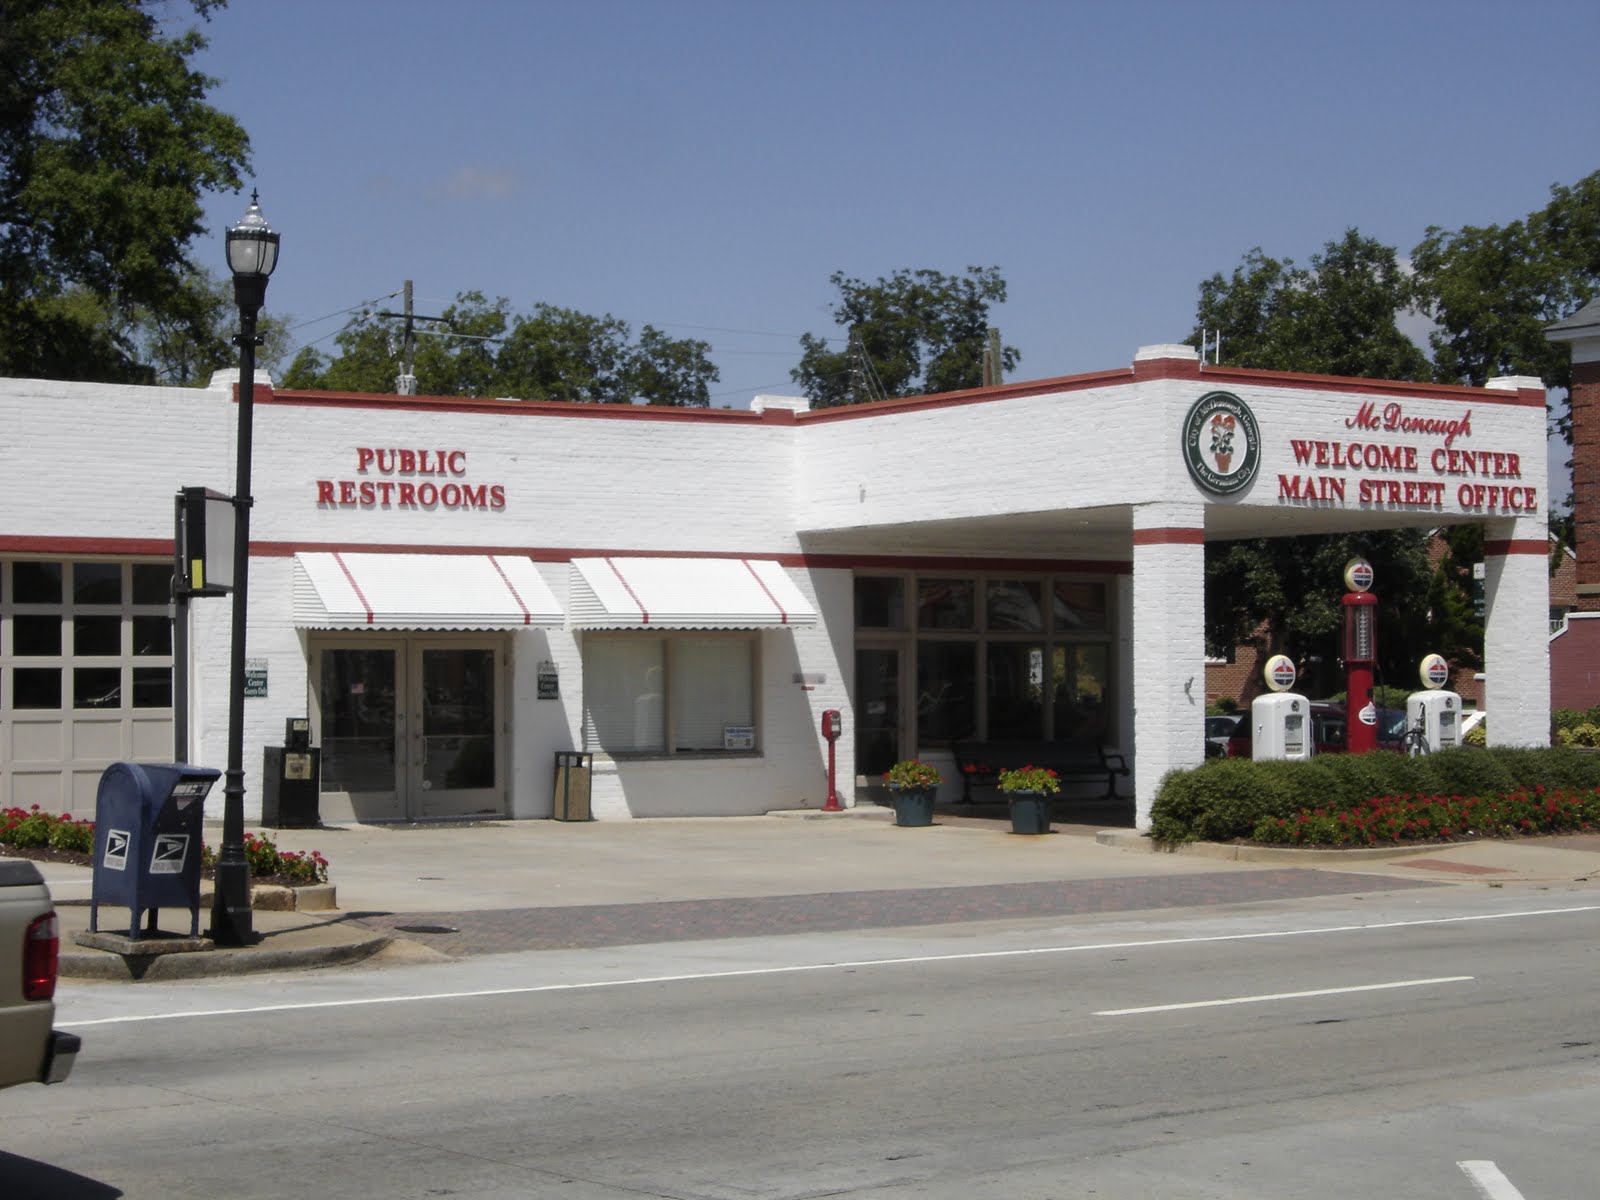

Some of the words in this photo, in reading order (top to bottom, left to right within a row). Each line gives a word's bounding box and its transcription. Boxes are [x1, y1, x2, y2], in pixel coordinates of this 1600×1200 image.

[1345, 401, 1471, 447] McDonough
[356, 447, 466, 475] PUBLIC
[1290, 440, 1418, 471] WELCOME
[1431, 448, 1521, 477] CENTER
[316, 480, 506, 509] RESTROOMS
[1278, 474, 1346, 503] MAIN
[1359, 479, 1445, 506] STREET
[1457, 483, 1538, 511] OFFICE
